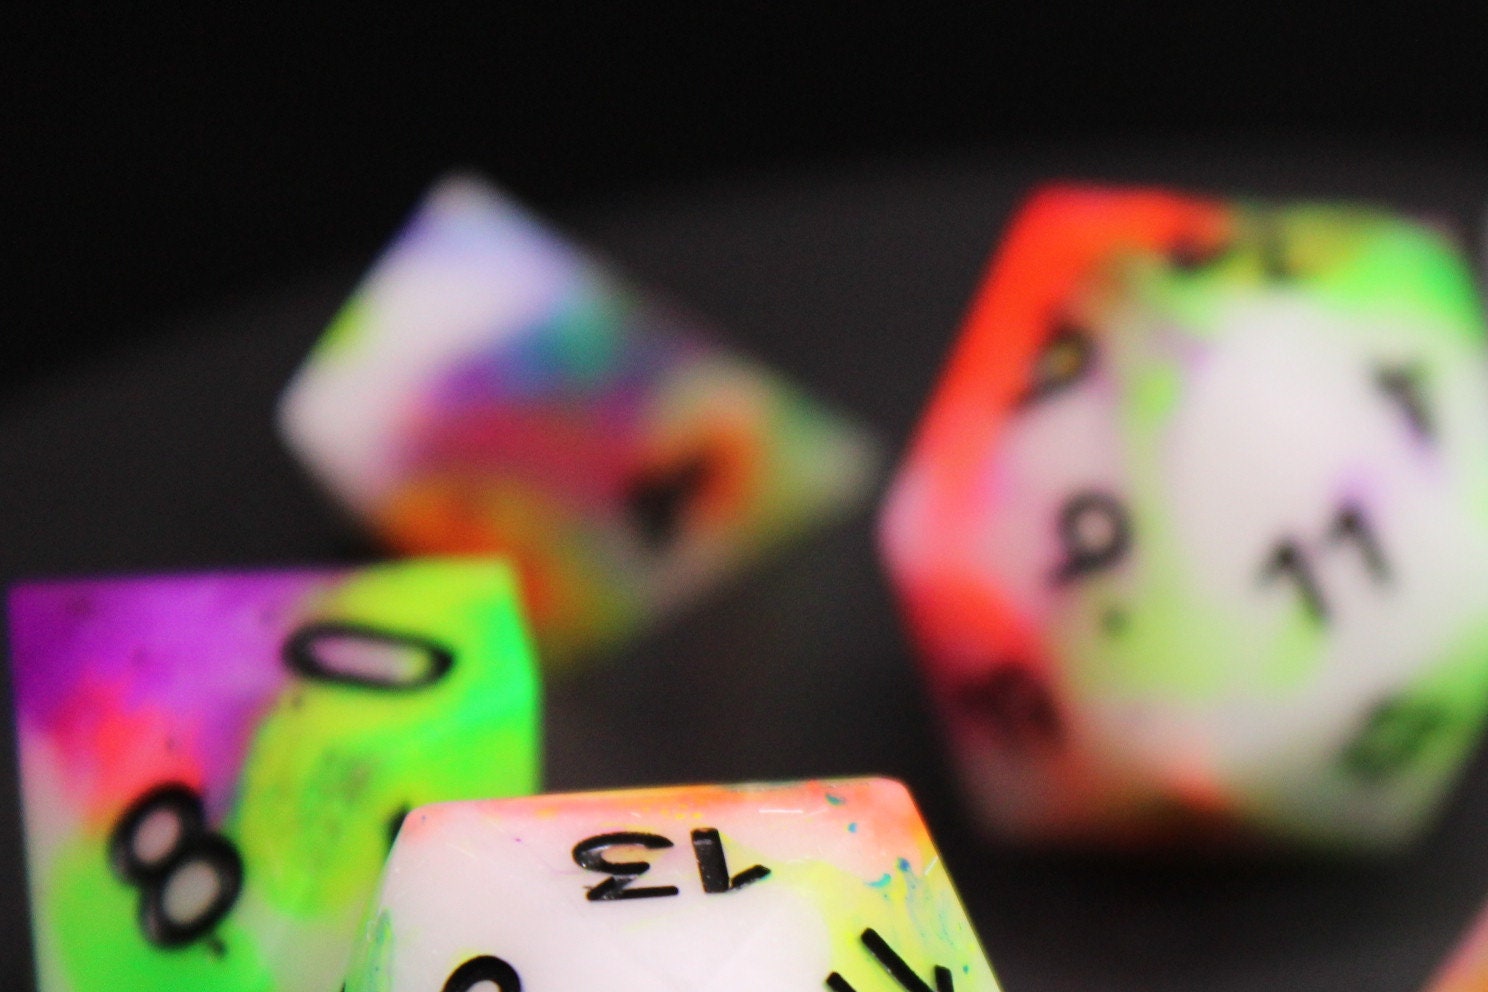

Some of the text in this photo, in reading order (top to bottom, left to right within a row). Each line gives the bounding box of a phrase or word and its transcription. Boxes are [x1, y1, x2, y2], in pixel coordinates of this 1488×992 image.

[1256, 497, 1394, 635] 11
[283, 621, 457, 691] 0
[109, 781, 244, 948] 8
[572, 828, 771, 901] 13
